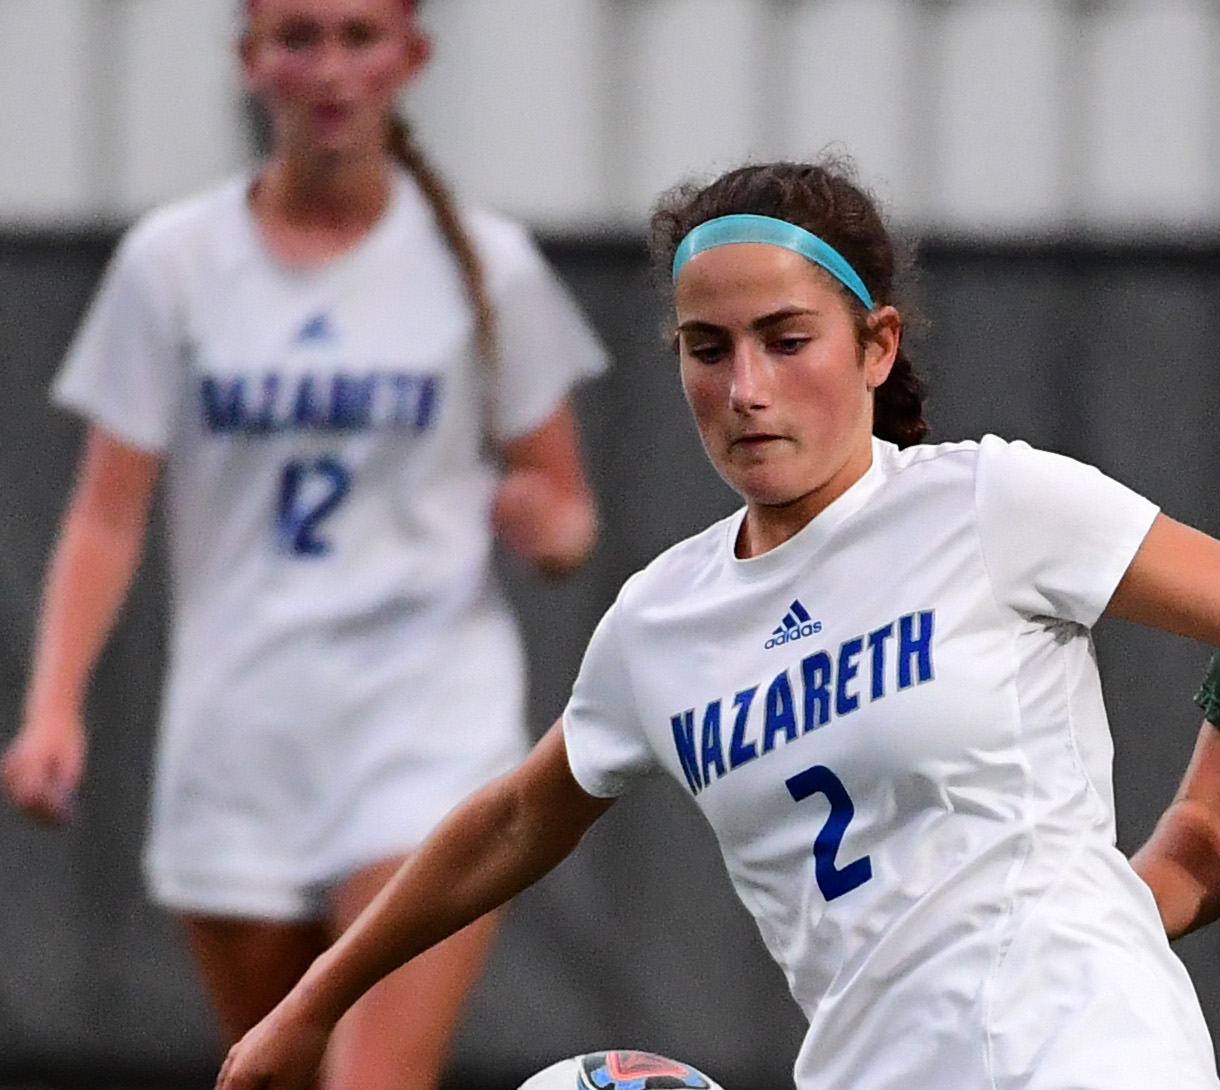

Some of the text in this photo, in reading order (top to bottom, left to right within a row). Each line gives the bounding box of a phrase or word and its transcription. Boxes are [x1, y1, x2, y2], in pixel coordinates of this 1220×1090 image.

[275, 455, 352, 555] 12
[764, 619, 823, 650] adidas
[669, 608, 936, 797] NAZARETH
[785, 764, 873, 902] 2
